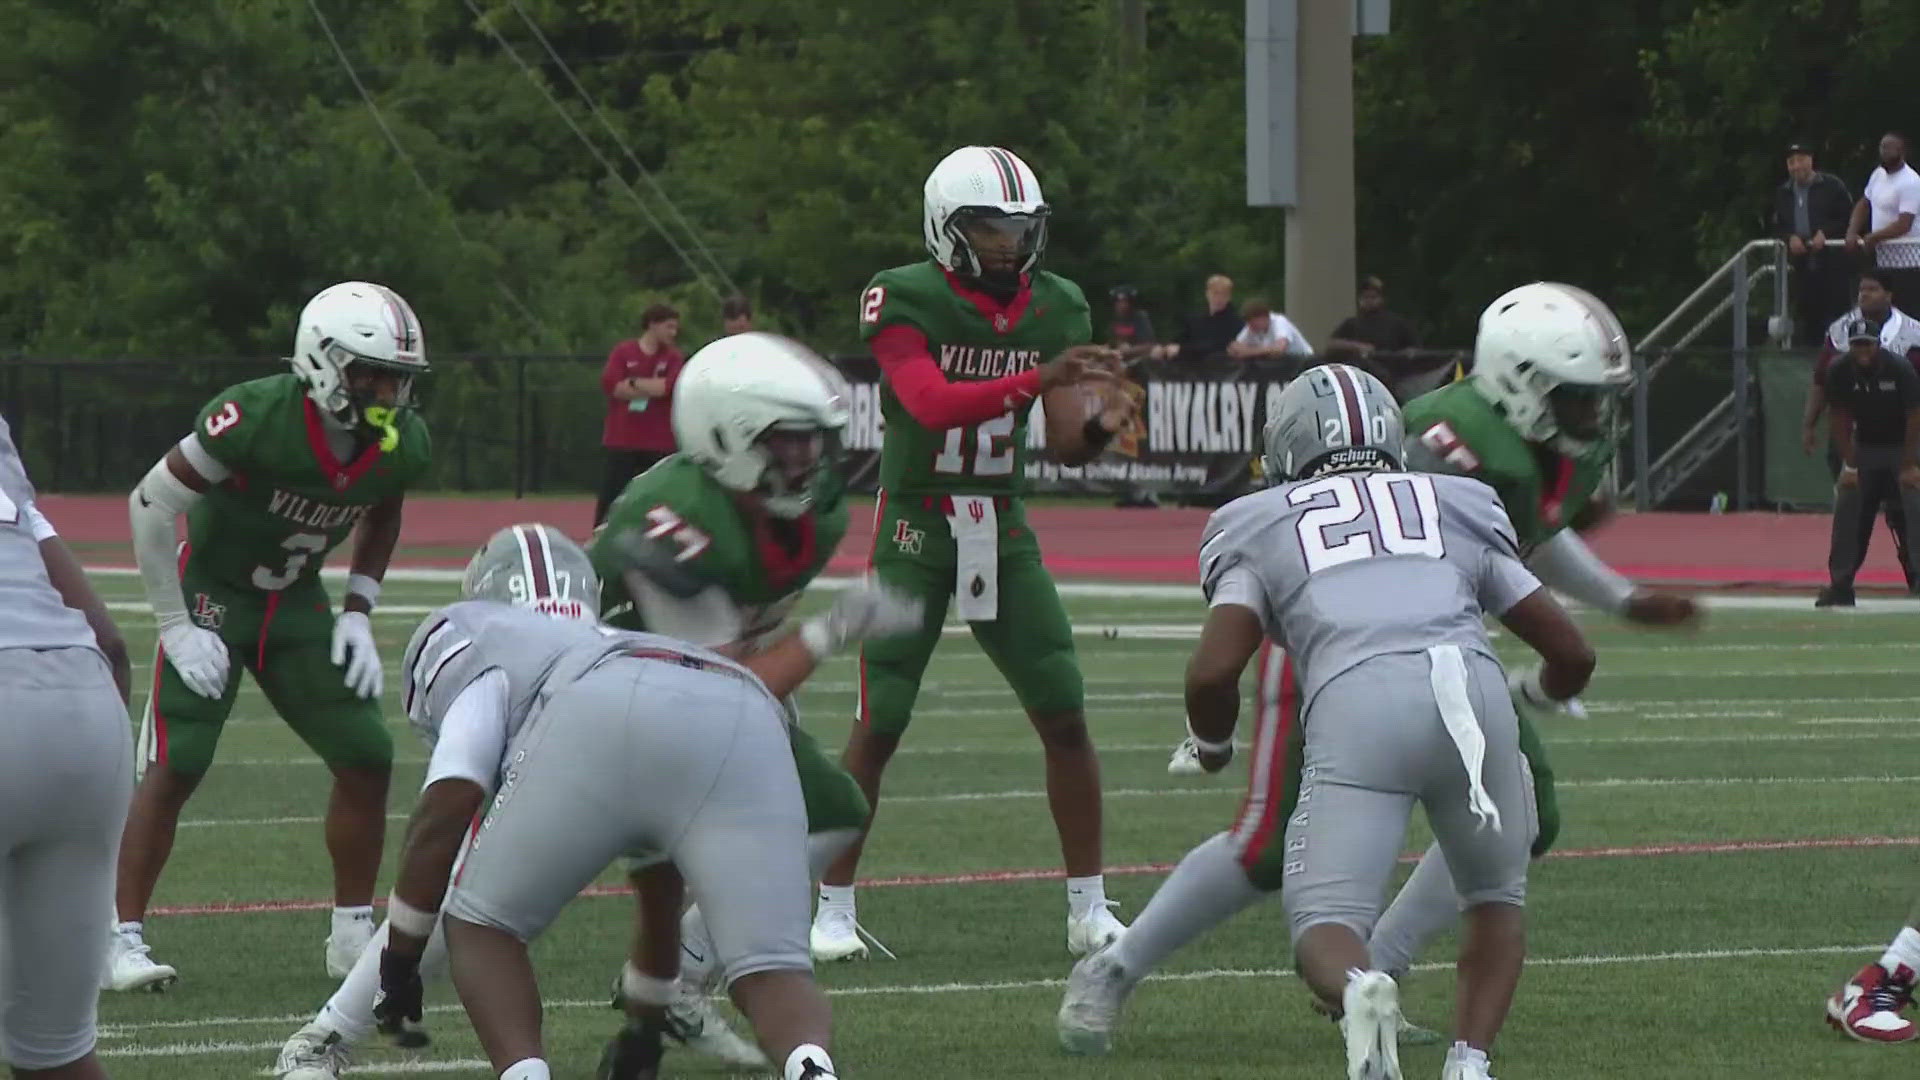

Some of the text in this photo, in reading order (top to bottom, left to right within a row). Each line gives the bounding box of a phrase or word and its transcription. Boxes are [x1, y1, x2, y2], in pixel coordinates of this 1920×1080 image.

[940, 344, 1040, 377] WILDCATS
[204, 402, 241, 437] 3
[934, 409, 1015, 476] 12
[1147, 382, 1258, 453] RIVALRY
[267, 489, 372, 528] WILDCAT
[643, 505, 713, 564] 77
[1285, 471, 1446, 574] 20
[252, 533, 327, 591] 3
